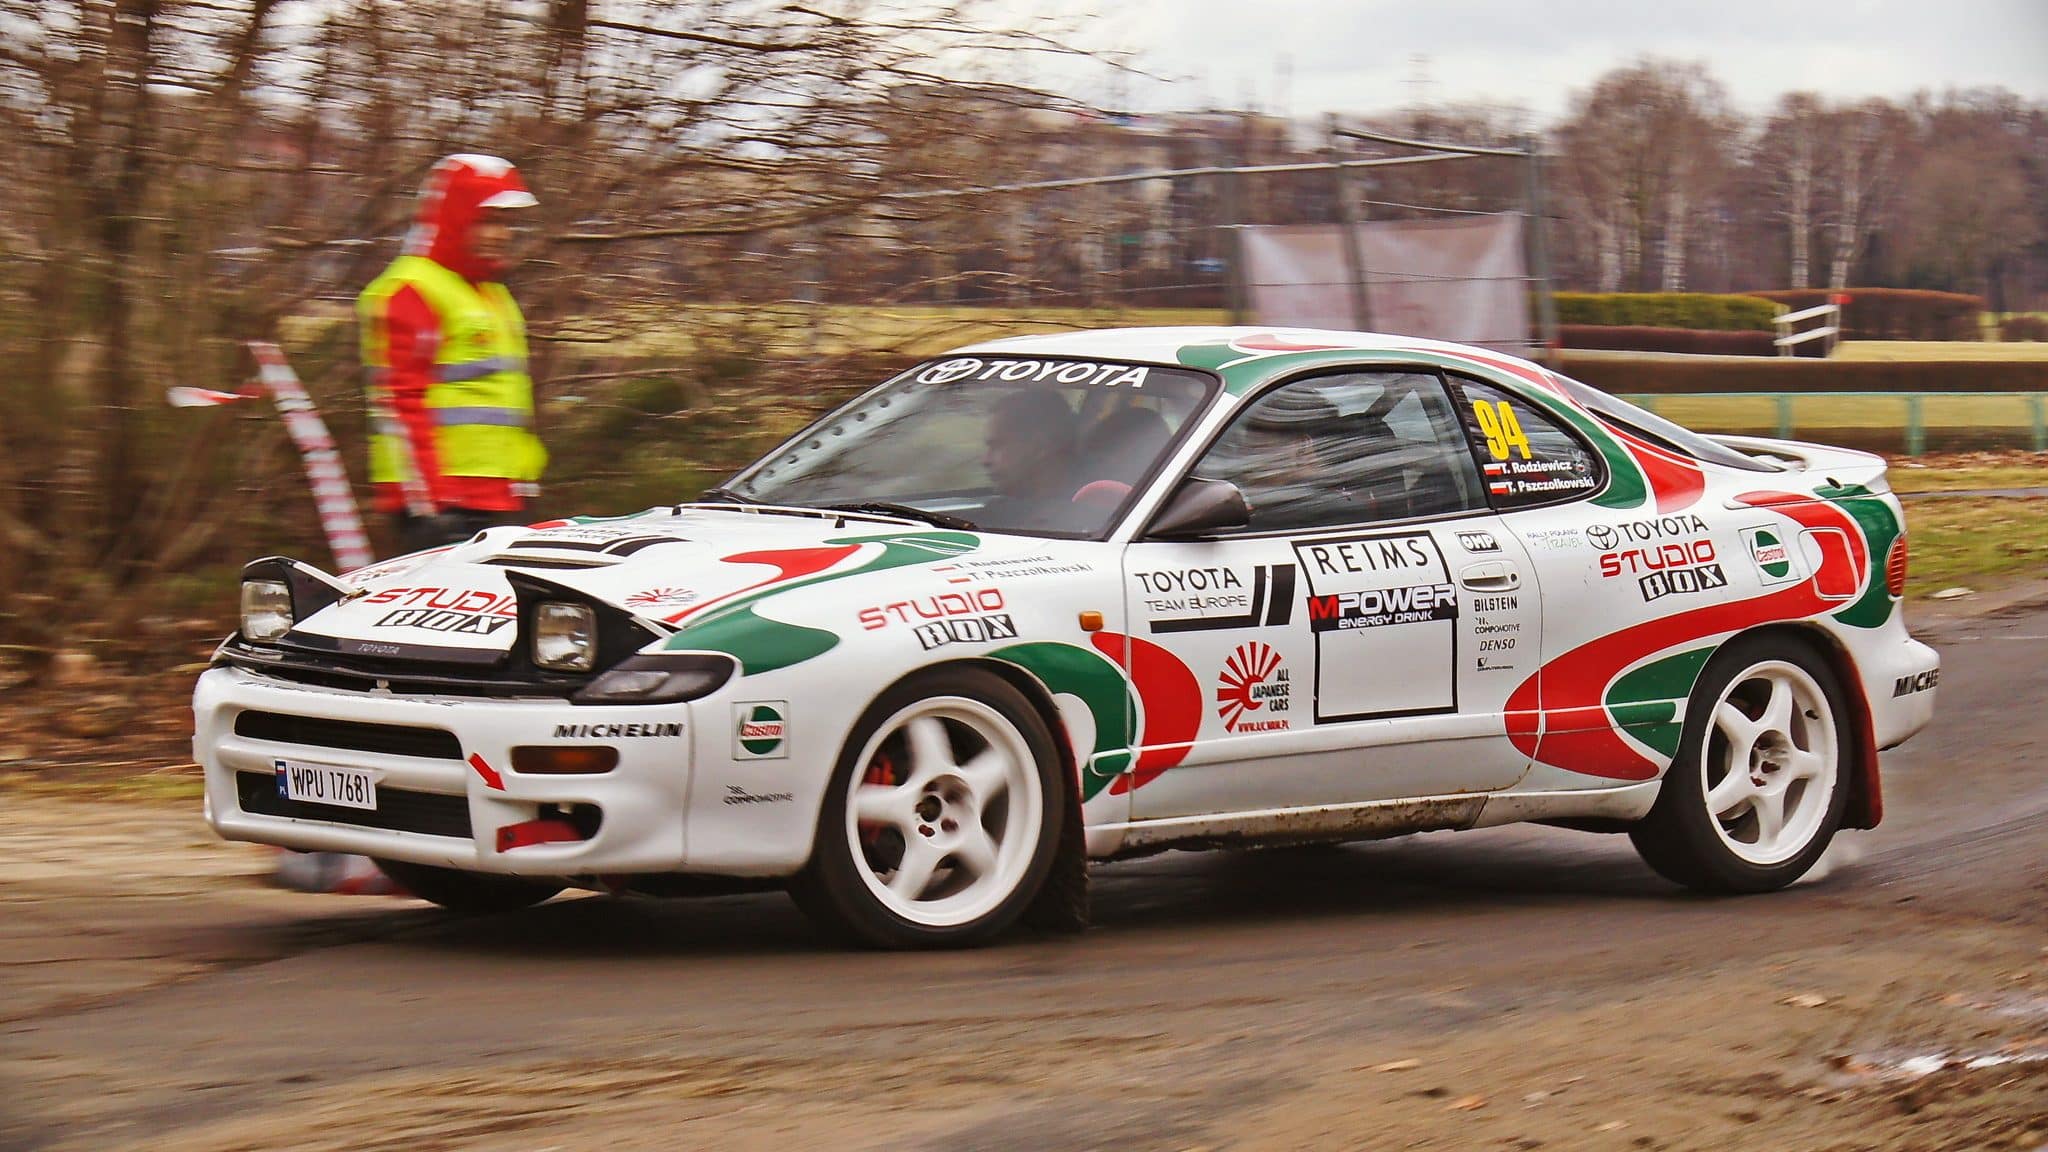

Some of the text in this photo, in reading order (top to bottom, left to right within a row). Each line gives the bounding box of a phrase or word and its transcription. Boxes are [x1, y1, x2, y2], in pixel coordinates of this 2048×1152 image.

[977, 360, 1150, 388] TOYOTA
[1473, 400, 1532, 460] 94
[1500, 460, 1573, 475] T. Rodziewicz
[1507, 481, 1517, 493] T.
[1618, 514, 1709, 542] TOYOTA
[1459, 533, 1500, 552] OMP
[1311, 539, 1428, 575] REIMS
[1600, 539, 1716, 578] STUDIO
[1134, 567, 1242, 594] TOYOTA
[1638, 563, 1729, 602] BOX
[858, 588, 1005, 631] STUDIO
[1145, 595, 1248, 612] TEAM EUROPE
[1474, 596, 1518, 612] BILSTEIN
[372, 608, 513, 635] BOX
[1394, 610, 1433, 622] DRINK
[912, 613, 1018, 651] BOX
[1474, 623, 1520, 634] COMPOMOTIVE
[358, 643, 401, 655] TOYOTA
[1480, 638, 1516, 651] DENSO
[1276, 669, 1289, 681] ALL
[1252, 683, 1289, 699] JAPANESE
[1269, 699, 1289, 712] CARS
[553, 723, 684, 738] MICHELIN
[291, 767, 371, 804] WPU 17681
